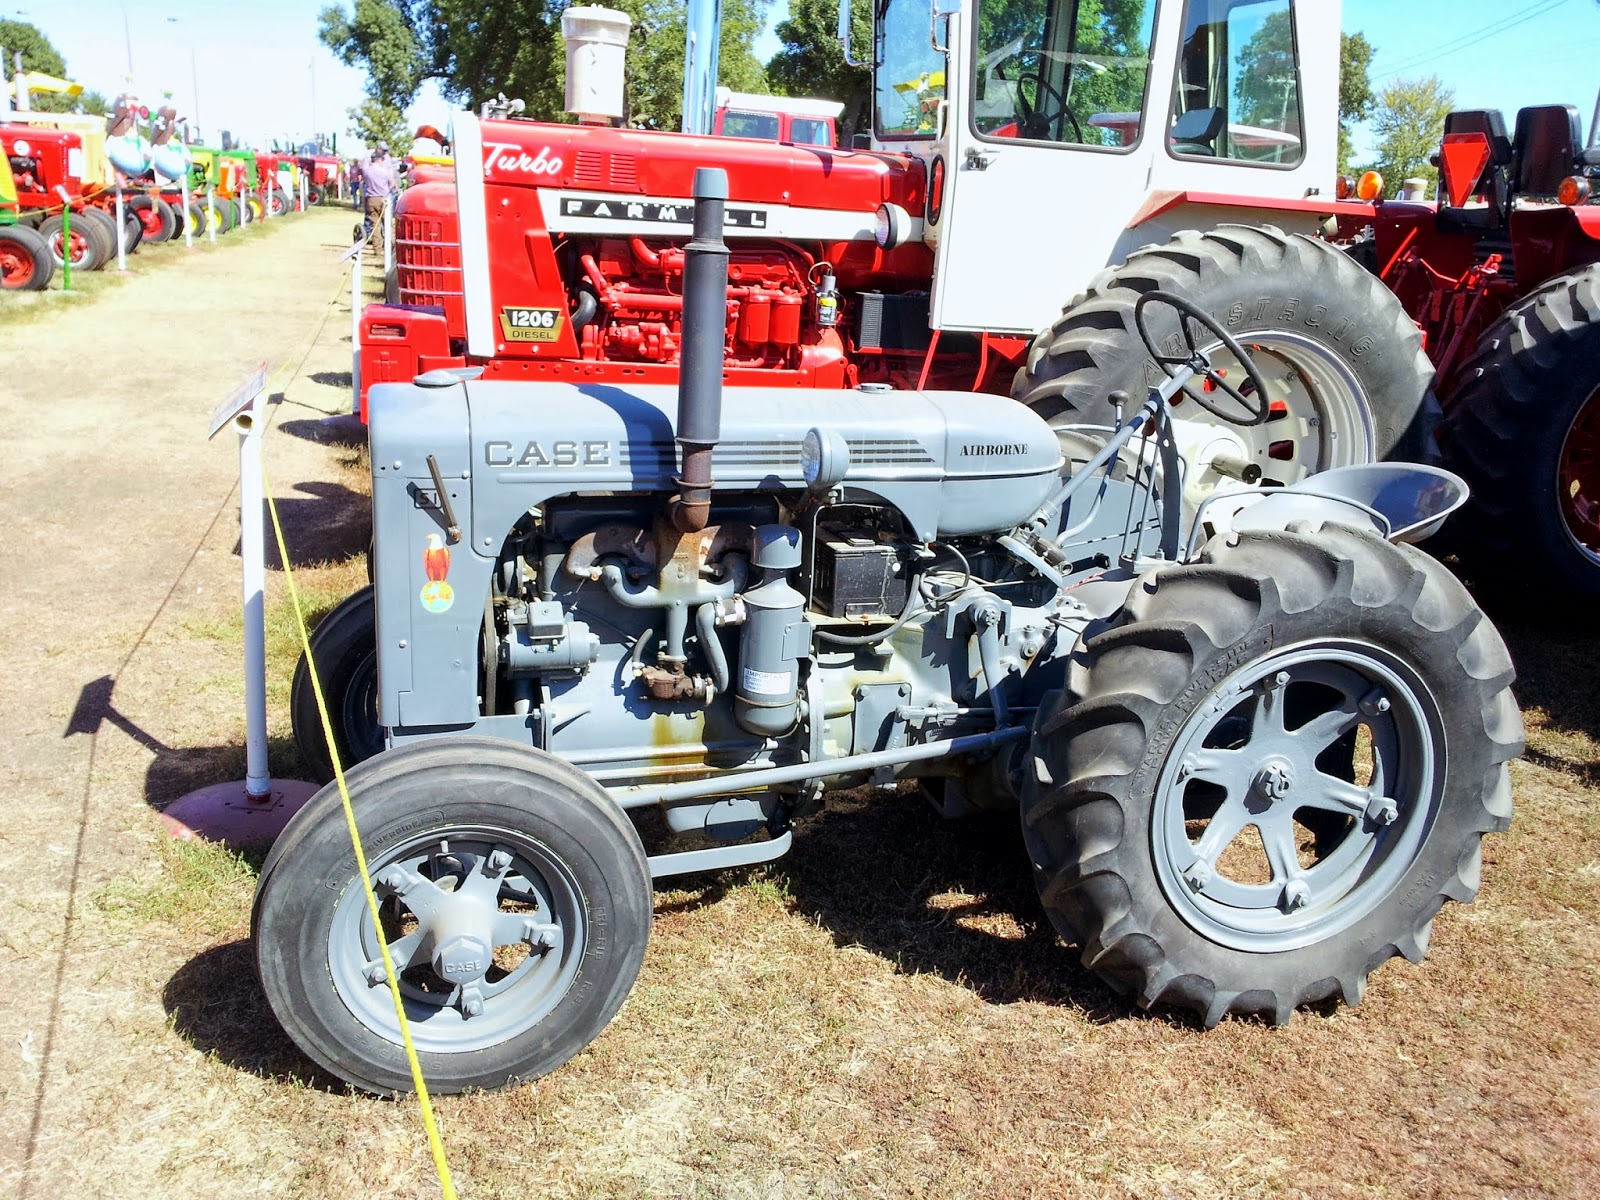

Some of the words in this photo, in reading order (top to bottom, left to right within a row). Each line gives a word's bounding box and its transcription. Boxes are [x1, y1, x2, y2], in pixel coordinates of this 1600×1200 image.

[482, 141, 563, 175] Turbo
[567, 200, 765, 226] FARMLL
[511, 310, 554, 328] 1206
[512, 330, 553, 339] DIESEL
[484, 440, 611, 468] CASE
[960, 444, 1028, 457] AIRBORNE
[445, 960, 481, 973] CASE
